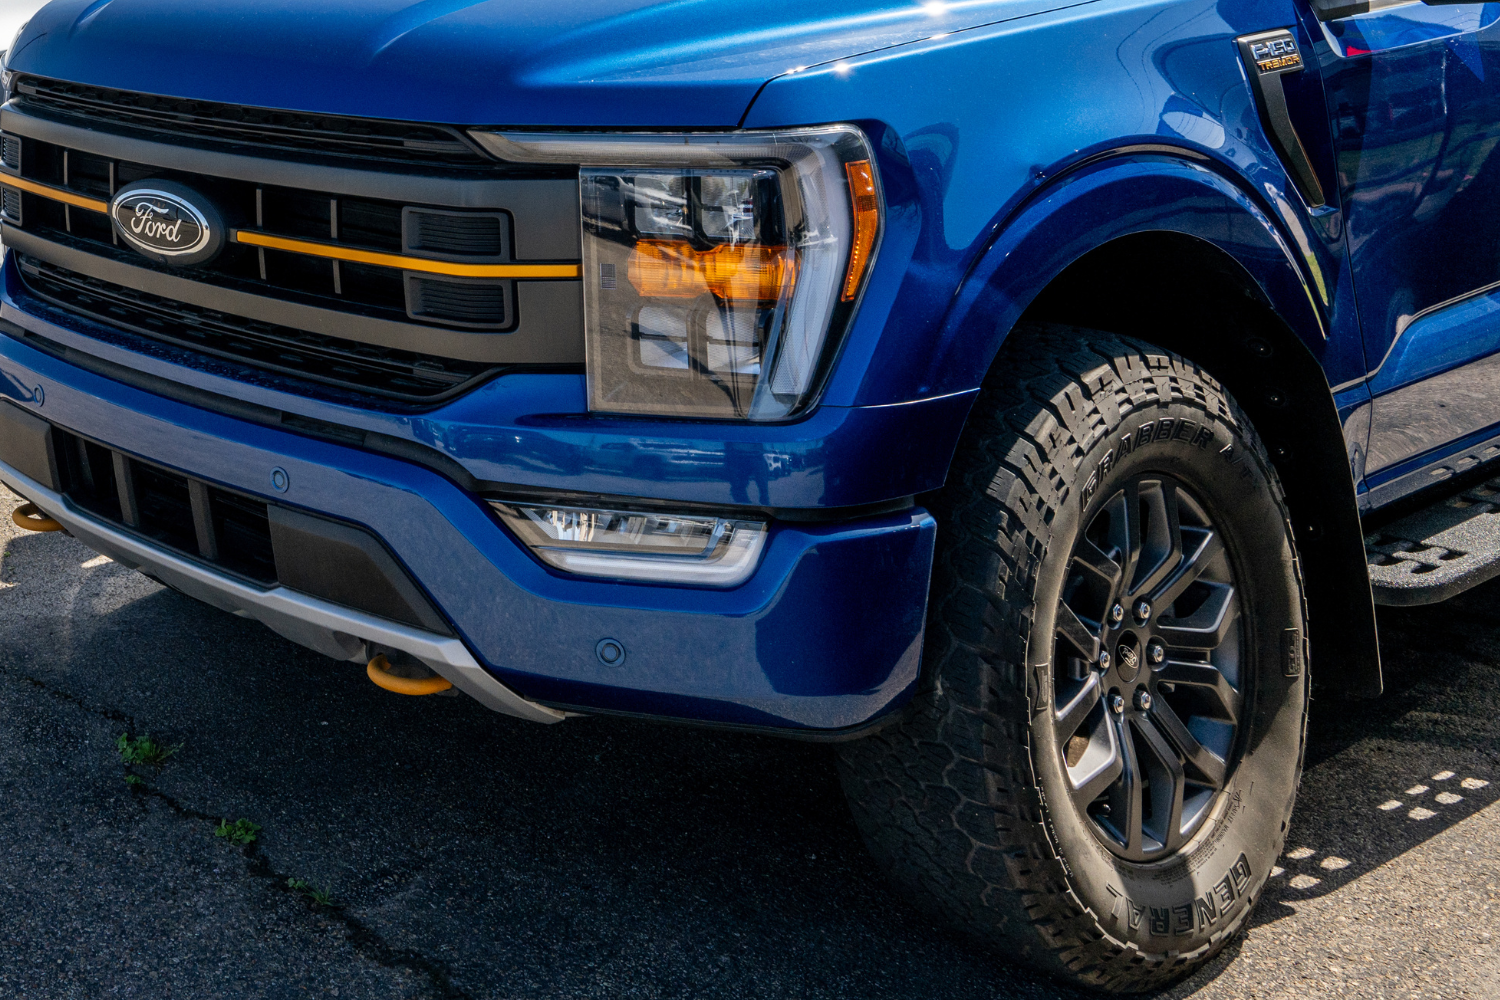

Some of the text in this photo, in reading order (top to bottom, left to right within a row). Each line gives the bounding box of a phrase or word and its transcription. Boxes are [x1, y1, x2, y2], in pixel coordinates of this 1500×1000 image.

[1258, 54, 1300, 70] TREMOR
[131, 202, 182, 242] Ford
[1082, 417, 1214, 512] GRABBER
[1106, 851, 1252, 937] GENERAL
